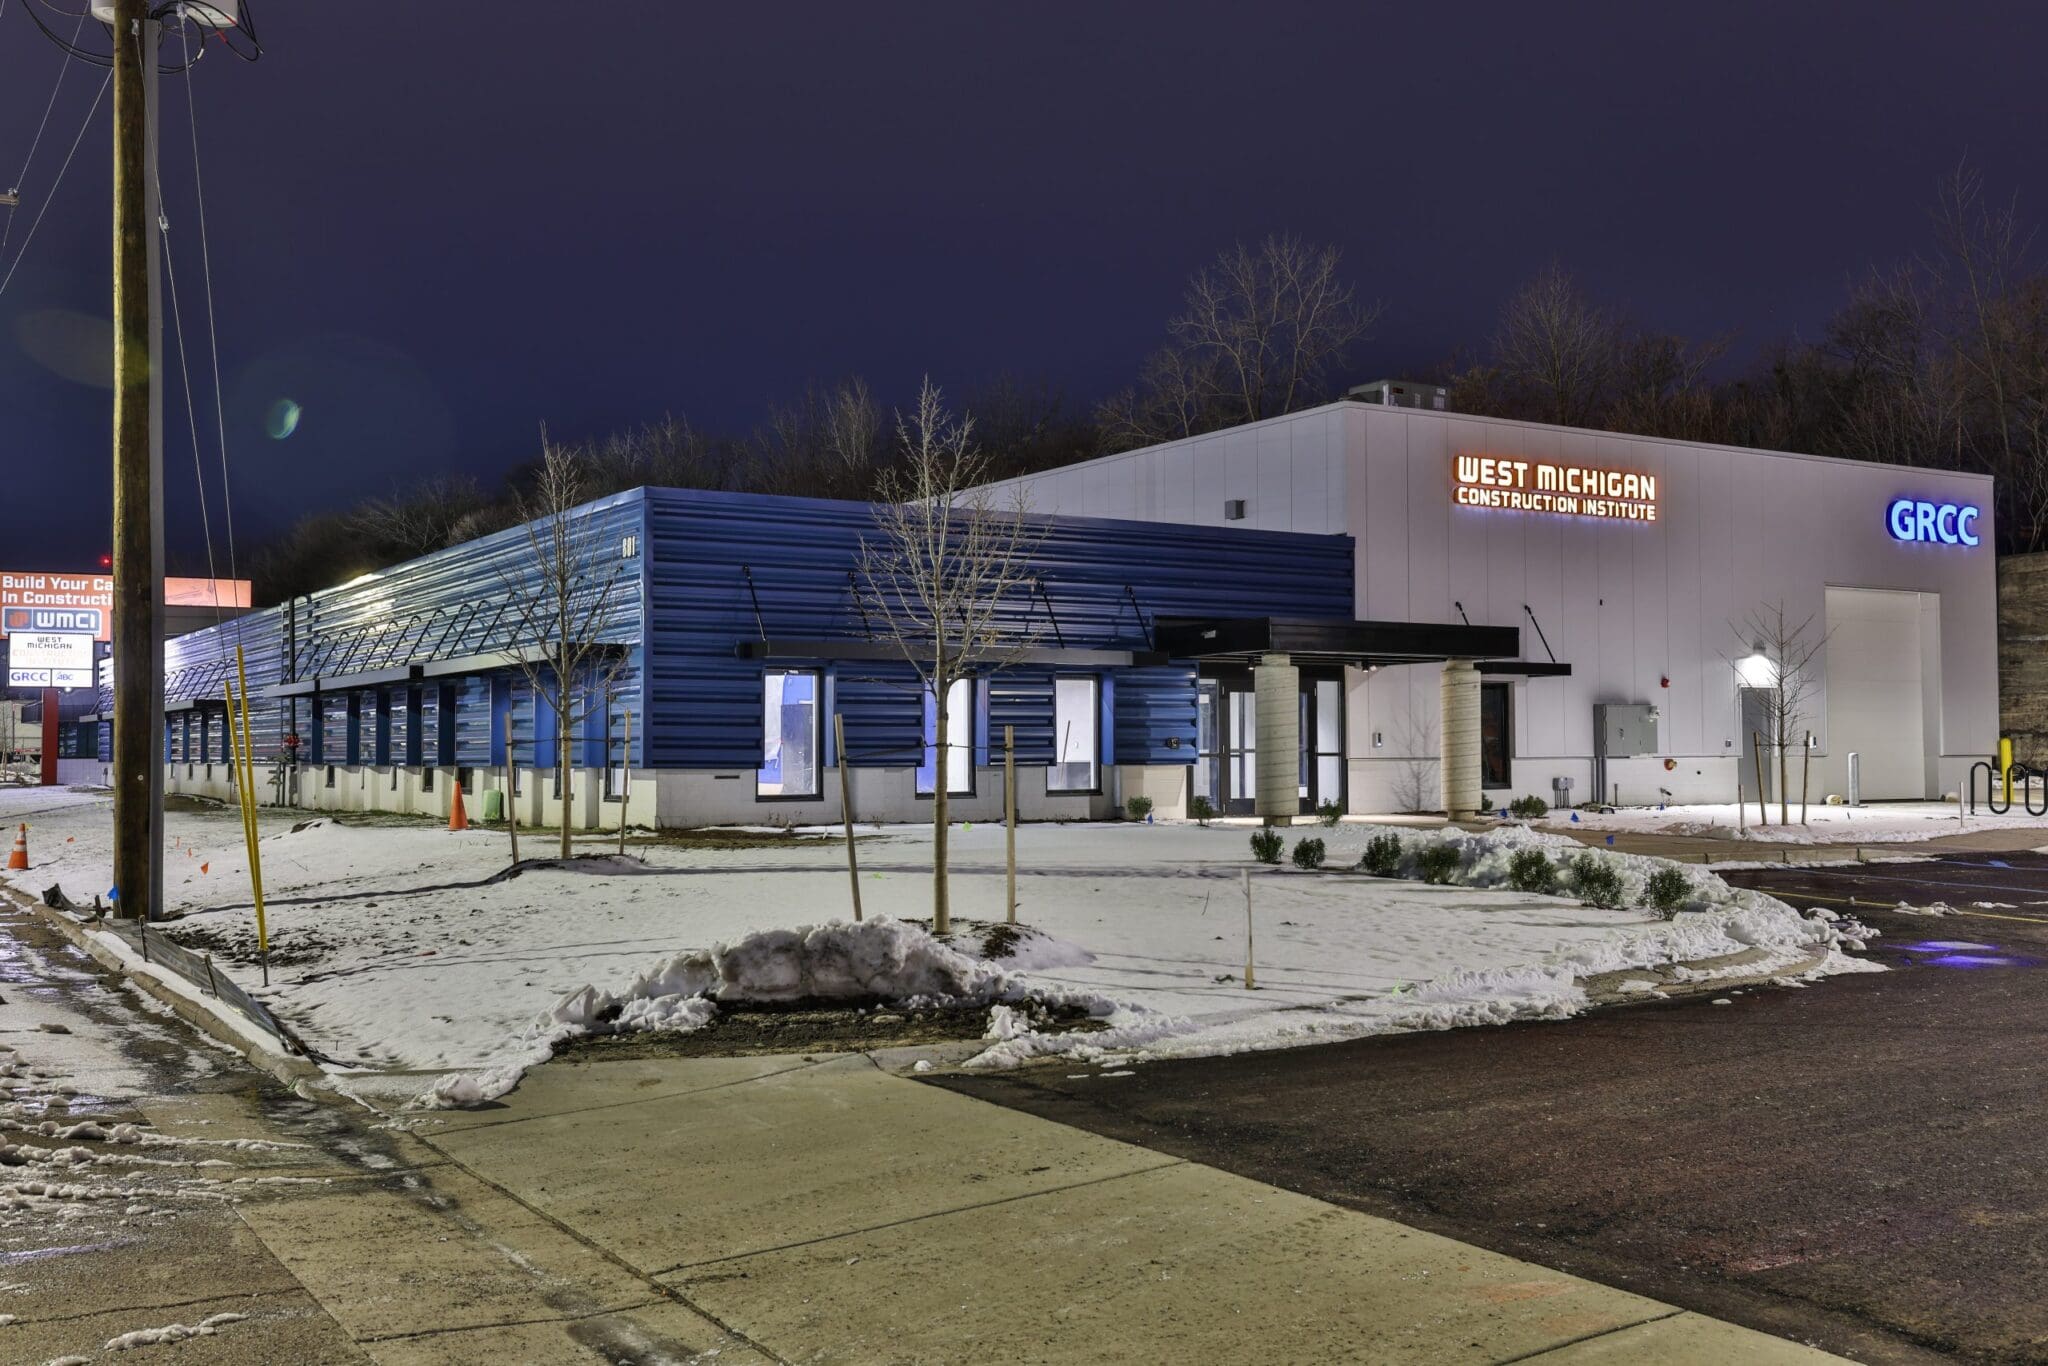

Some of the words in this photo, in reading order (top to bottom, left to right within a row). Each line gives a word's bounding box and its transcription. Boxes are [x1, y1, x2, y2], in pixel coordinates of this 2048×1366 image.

[1457, 455, 1528, 488] WEST
[1536, 464, 1656, 500] MICHIGAN
[1457, 486, 1578, 514] CONSTRUCTION
[1582, 499, 1656, 521] INSTITUTE
[1889, 499, 1979, 546] GRCC
[2, 575, 46, 589] Build
[50, 577, 88, 590] Your
[94, 578, 113, 591] Ca
[2, 590, 18, 604] In
[23, 591, 112, 605] Constructi
[36, 611, 96, 629] WMCI
[10, 671, 49, 682] GRCC
